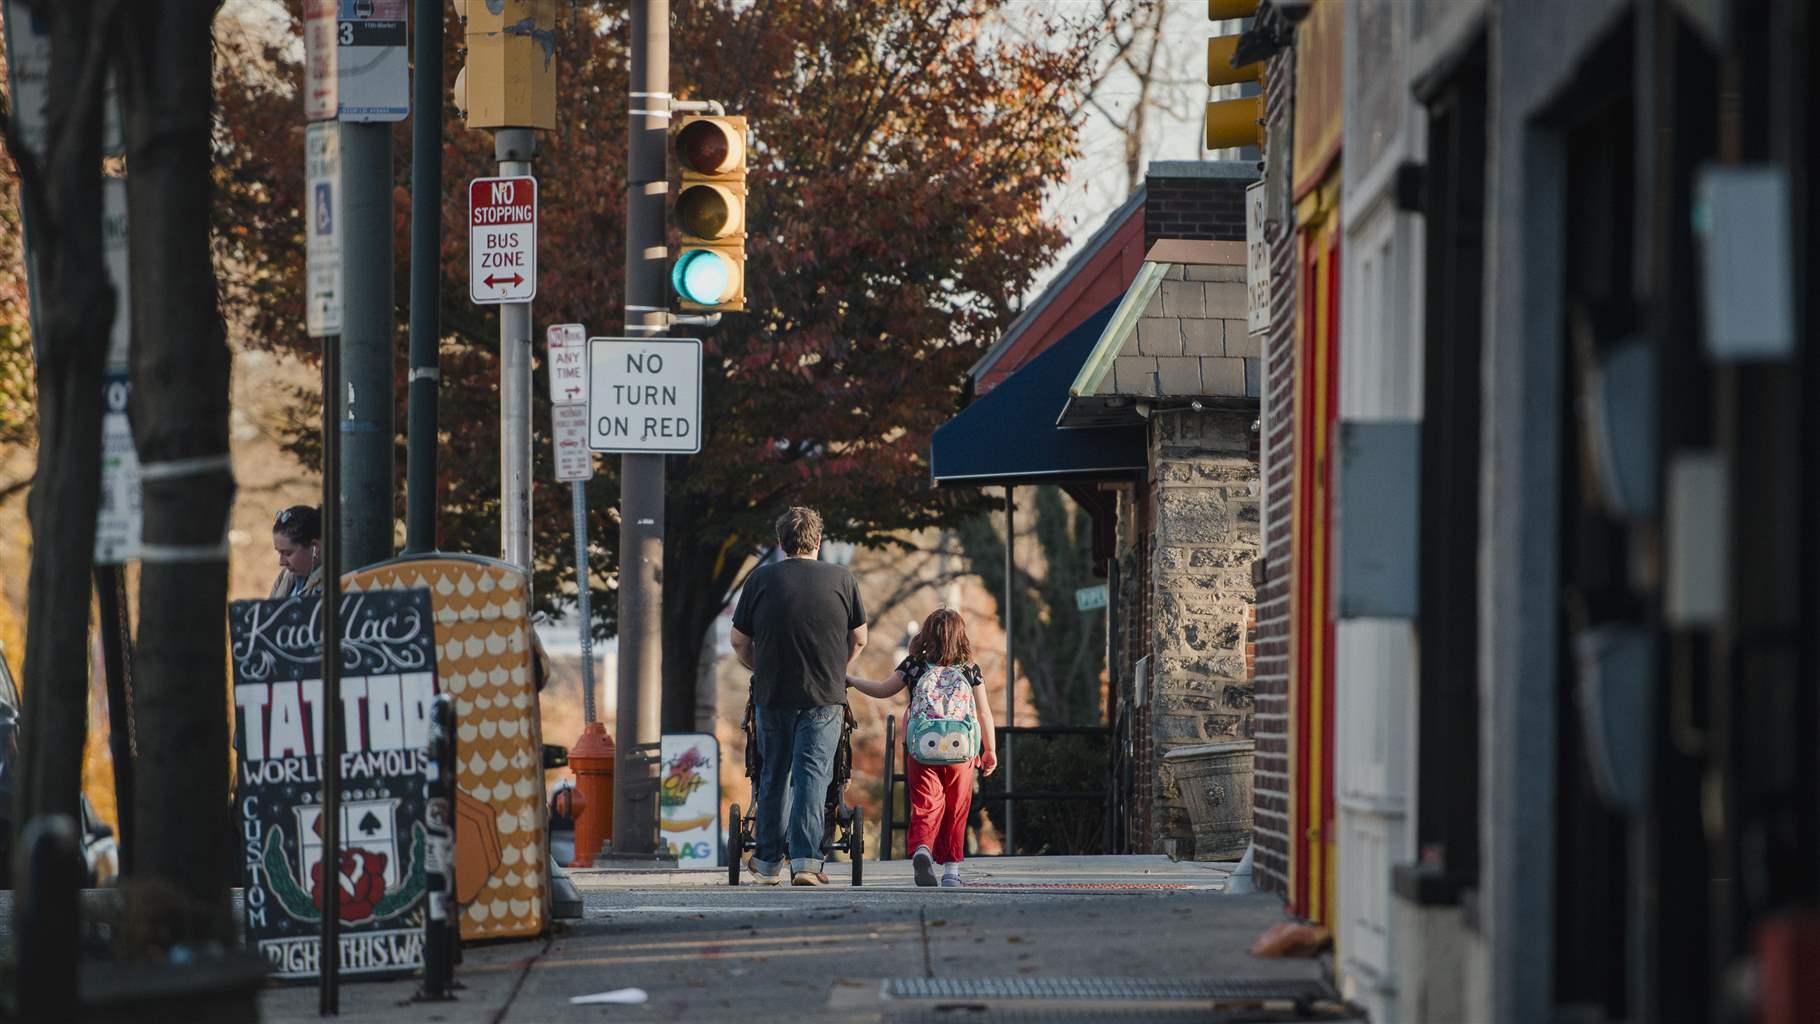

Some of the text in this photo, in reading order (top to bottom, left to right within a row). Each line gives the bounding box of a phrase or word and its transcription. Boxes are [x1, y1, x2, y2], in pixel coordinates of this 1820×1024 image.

[336, 22, 354, 45] 3
[491, 181, 515, 206] NO
[474, 205, 532, 223] STOPPING
[487, 232, 519, 250] BUS
[481, 251, 525, 268] ZONE
[556, 352, 580, 365] ANY
[626, 353, 663, 374] NO
[557, 367, 582, 379] TIME
[613, 385, 676, 406] TURN
[598, 416, 690, 438] ON RED
[234, 595, 420, 663] Kadlac
[235, 671, 434, 761] TATTOO
[340, 747, 431, 780] FAMOUS
[243, 797, 267, 928] CUSTOM
[266, 940, 321, 973] RIGH
[338, 935, 389, 970] THIS
